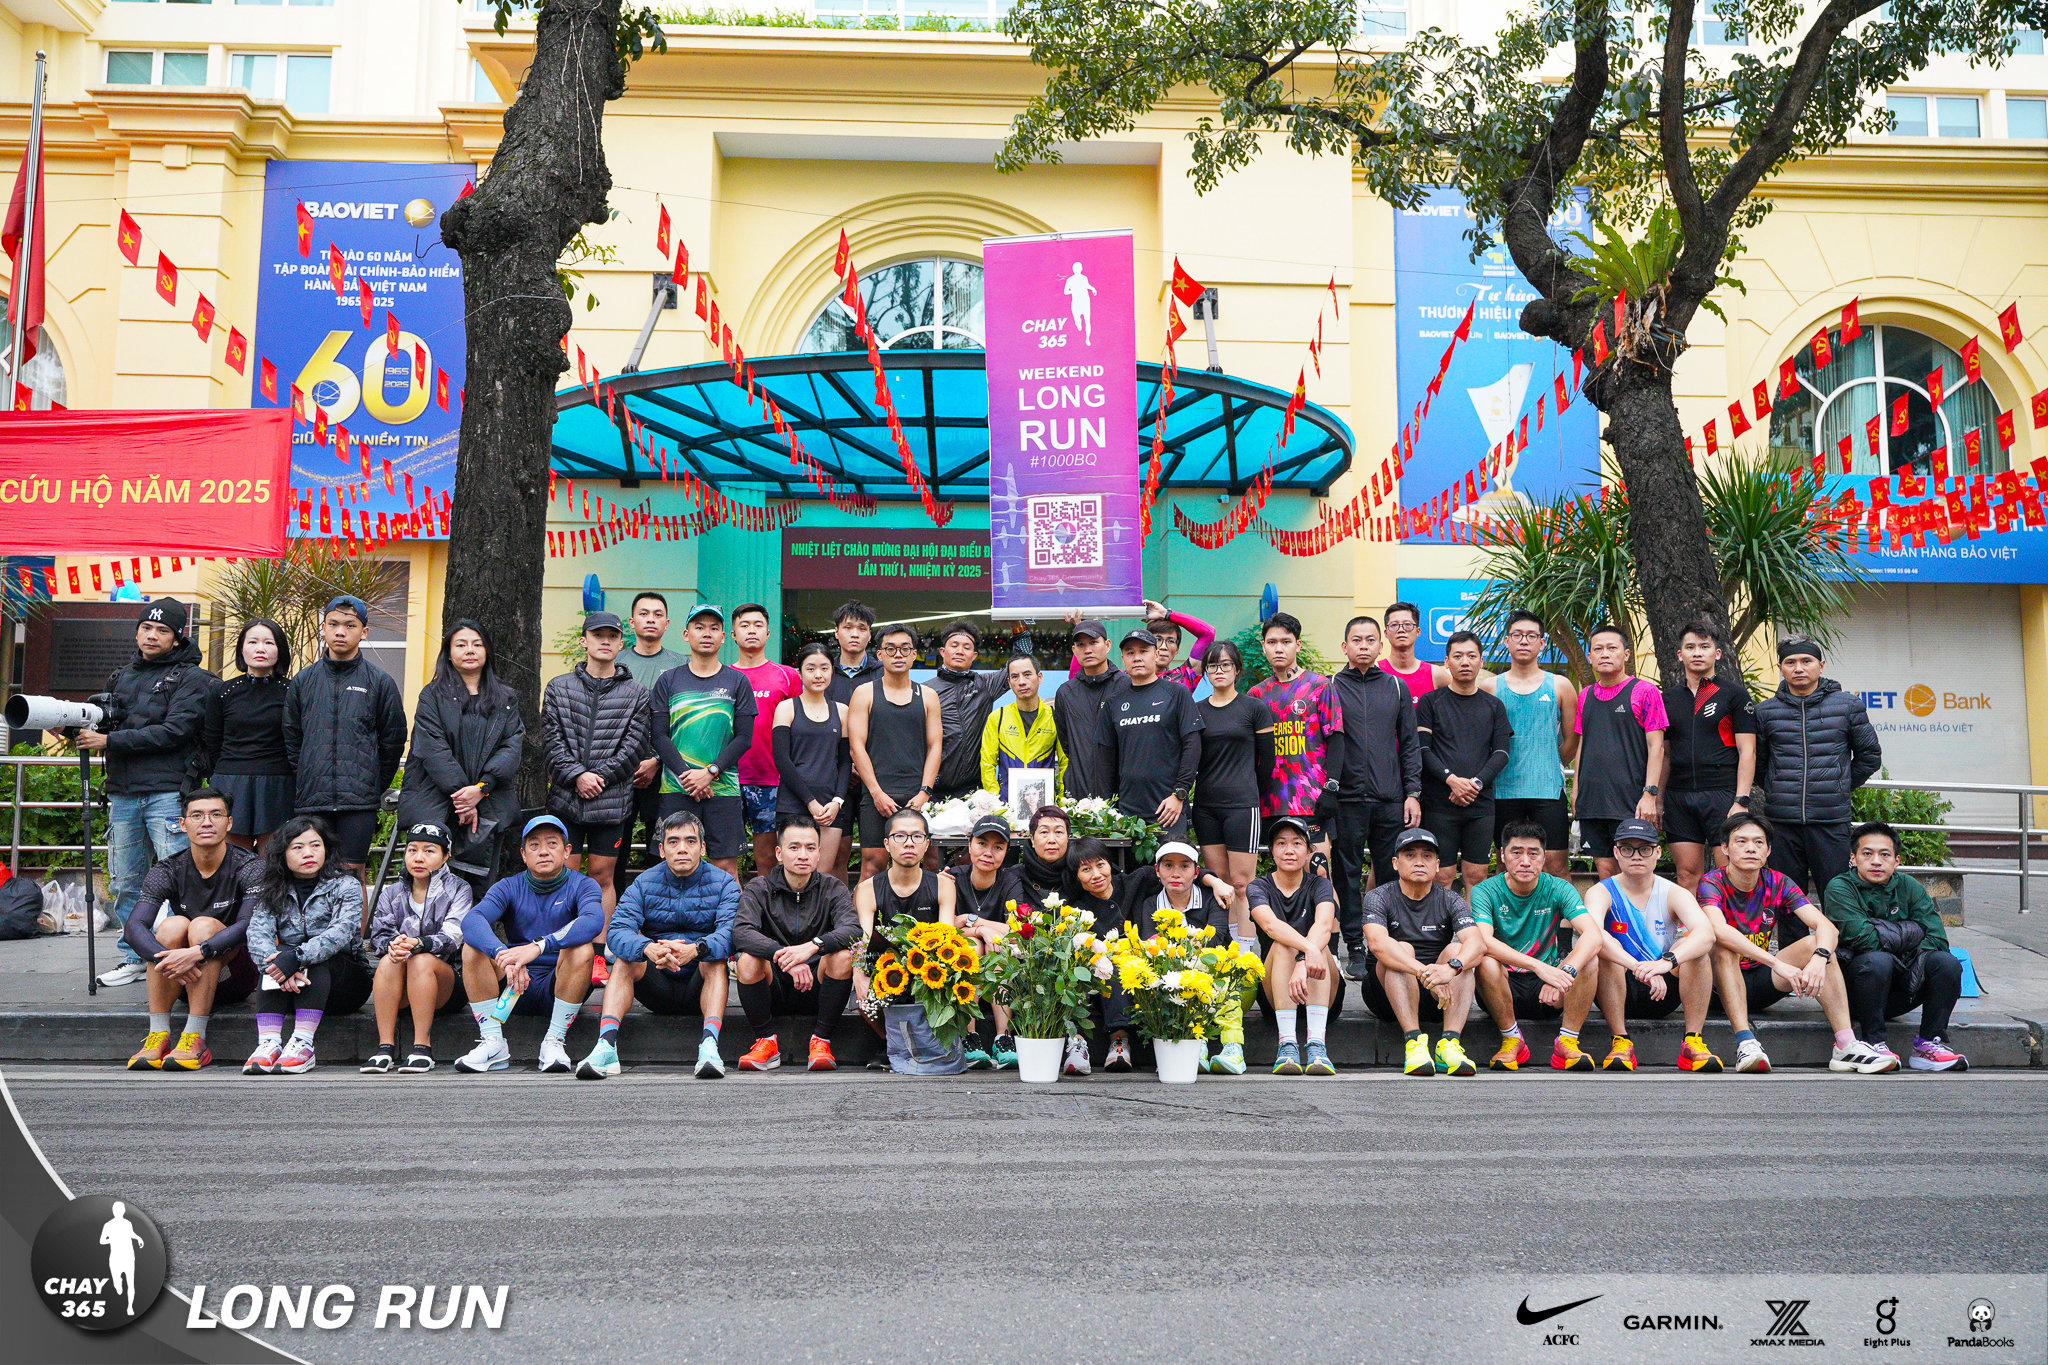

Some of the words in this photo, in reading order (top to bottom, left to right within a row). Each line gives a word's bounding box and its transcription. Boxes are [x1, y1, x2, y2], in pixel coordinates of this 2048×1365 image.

[304, 201, 399, 220] BAOVIET
[1402, 205, 1461, 217] BAOVIET
[367, 251, 382, 261] 60
[384, 249, 413, 262] NĂM
[273, 263, 298, 279] TẬP
[359, 263, 426, 278] CHÍNH-BẢO
[429, 262, 460, 278] HIỂM
[370, 280, 397, 294] VIỆT
[399, 282, 427, 292] NAM
[1455, 282, 1502, 304] Tự
[1480, 305, 1511, 322] HIỆU
[1021, 317, 1068, 333] CHAY
[1038, 334, 1067, 349] 365
[293, 330, 433, 425] 60
[385, 367, 409, 375] 1965
[1018, 365, 1104, 380] WEEKEND
[384, 380, 409, 388] 2025
[1018, 383, 1105, 411] LONG
[404, 435, 428, 447] TIN
[1019, 417, 1106, 451] RUN
[1029, 453, 1097, 468] #1000BQ
[0, 474, 61, 503] CỨU
[70, 474, 113, 509] HỘ
[121, 474, 191, 503] NĂM
[199, 479, 271, 503] 2025
[791, 541, 819, 558] NHIỆT
[821, 541, 841, 558] LIỆT
[903, 544, 920, 559] ĐẠI
[922, 542, 938, 559] HỘI
[940, 545, 957, 560] ĐẠI
[959, 541, 982, 558] BIỂU
[1881, 547, 1917, 558] NGÂN
[1921, 545, 1957, 558] HÀNG
[1961, 545, 1986, 559] BẢO
[1989, 545, 2018, 560] VIỆT
[879, 560, 899, 576] THỨ
[909, 561, 941, 579] NHIỆM
[957, 564, 982, 577] 2025
[1943, 692, 1992, 709] Bank
[1119, 714, 1161, 727] CHAY365
[1273, 721, 1293, 736] EARS
[1294, 719, 1306, 734] OF
[1899, 722, 1927, 732] HÀNG
[1929, 721, 1950, 732] BẢO
[1952, 721, 1974, 733] VIỆT
